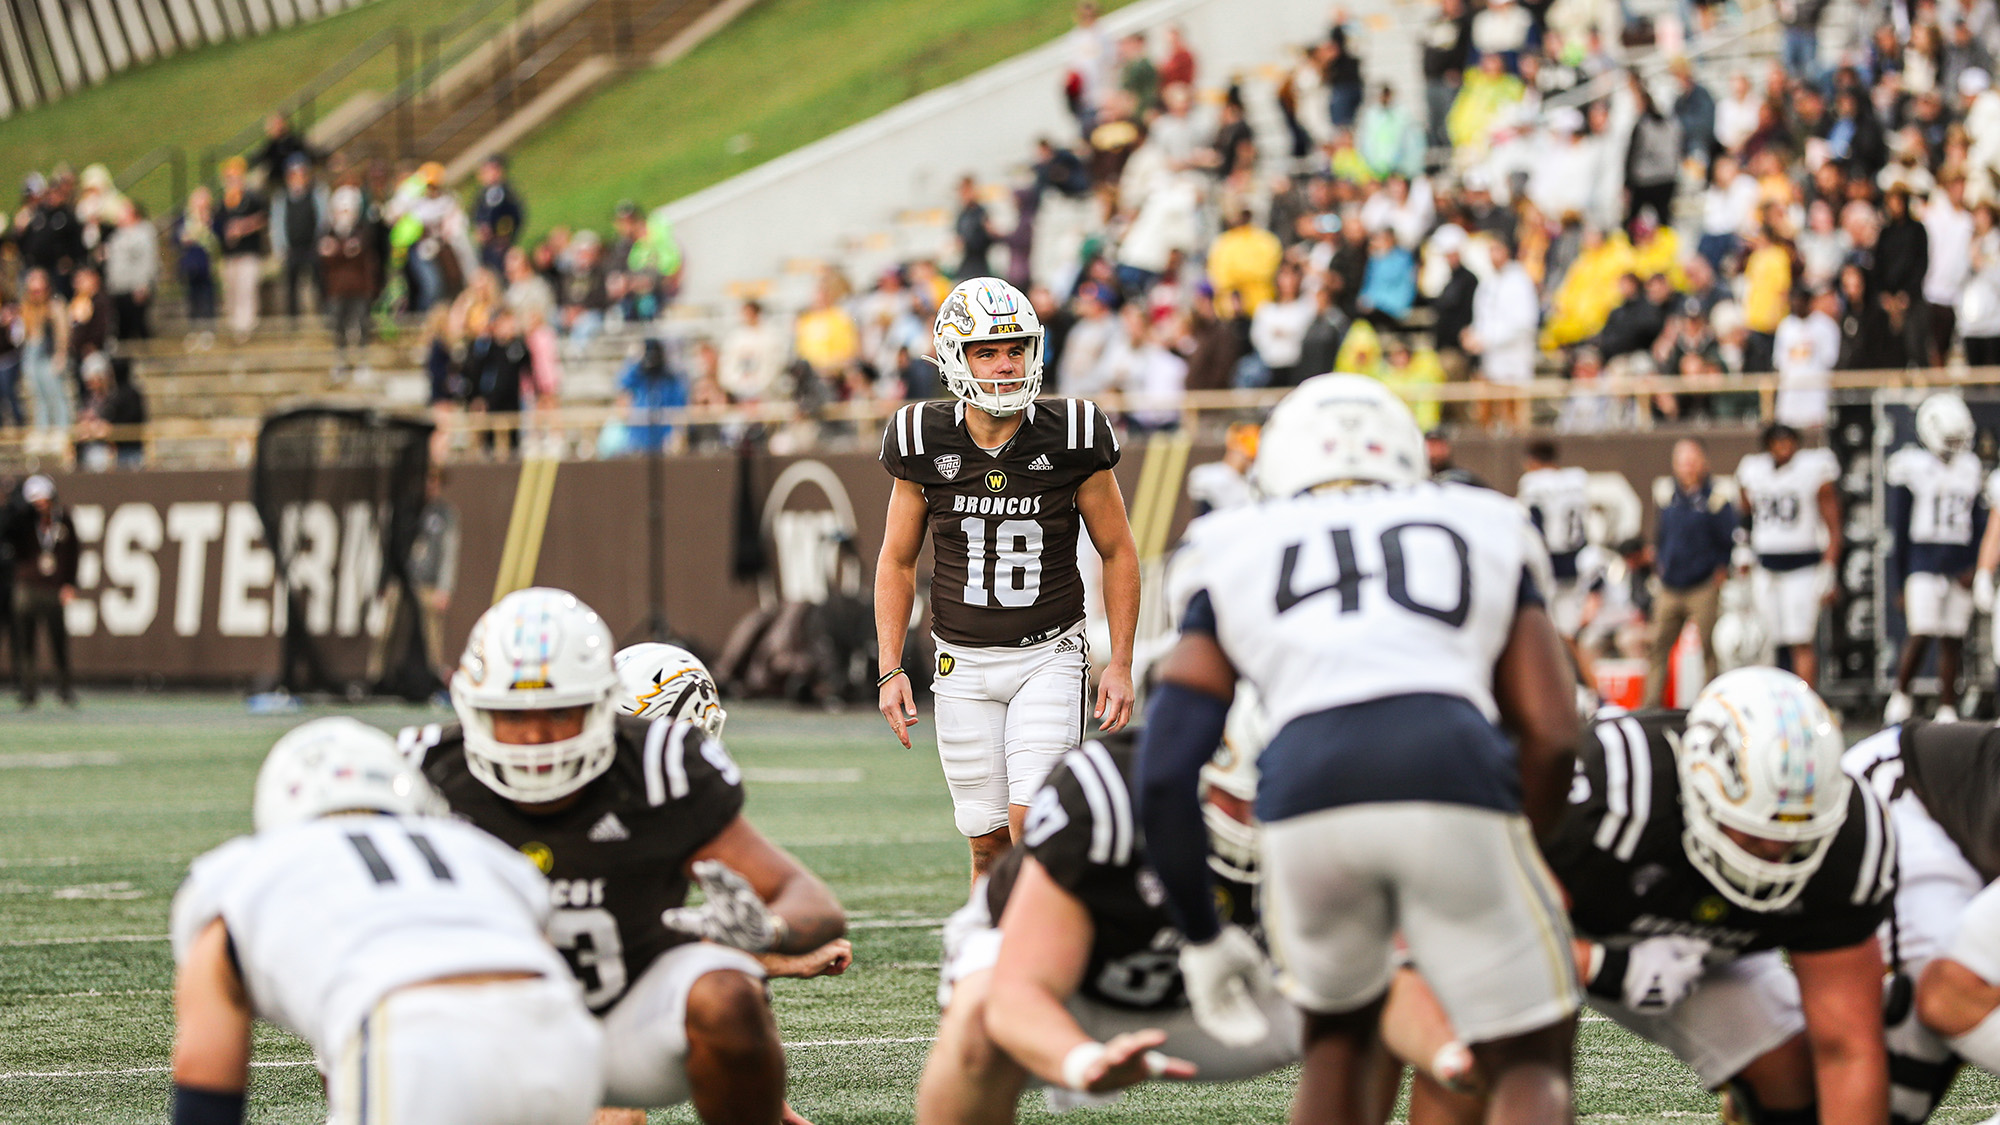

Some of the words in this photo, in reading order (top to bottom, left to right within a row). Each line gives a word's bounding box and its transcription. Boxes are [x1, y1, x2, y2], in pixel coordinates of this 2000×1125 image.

[997, 324, 1016, 334] EAT
[937, 461, 960, 471] MAC
[988, 475, 1003, 489] W
[952, 494, 1043, 515] BRONCOS
[64, 501, 388, 637] ESTERN
[960, 516, 1044, 608] 18
[1275, 521, 1469, 628] 40
[1054, 644, 1078, 654] adidas
[940, 657, 953, 673] W
[346, 833, 455, 884] 11
